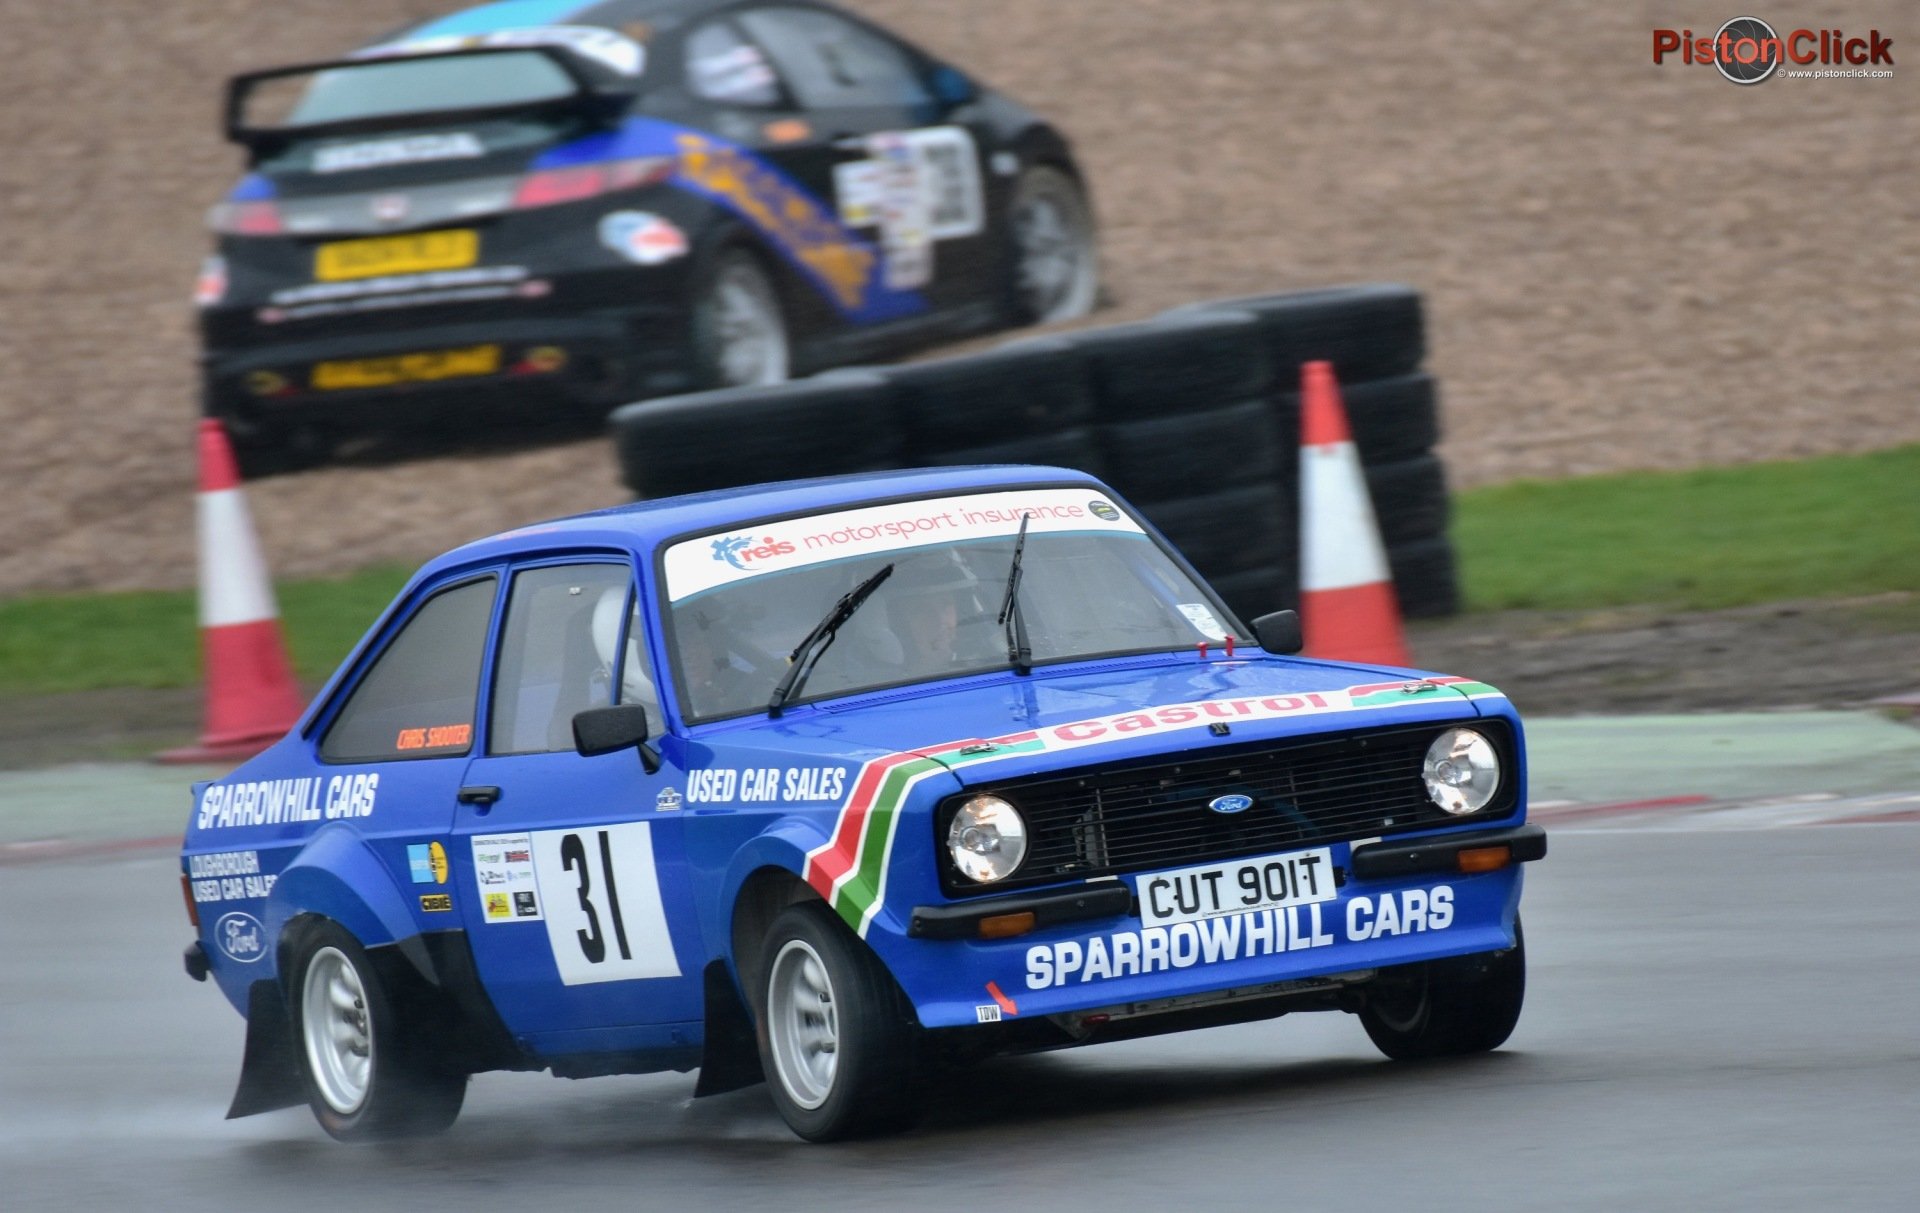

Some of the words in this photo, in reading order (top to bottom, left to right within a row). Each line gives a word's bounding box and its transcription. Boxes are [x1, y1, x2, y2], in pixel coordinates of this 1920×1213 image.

[740, 536, 796, 562] reis
[803, 512, 957, 549] motorsport
[959, 505, 1084, 525] insurance
[198, 776, 322, 829] SPARROWHILL
[325, 773, 379, 819] CARS
[687, 769, 737, 803] USED
[740, 768, 780, 801] CAR
[783, 767, 847, 801] SALES
[192, 880, 222, 902] USED
[221, 877, 246, 900] CAR
[560, 830, 633, 964] 31
[1148, 870, 1224, 919] CUT
[1237, 856, 1321, 906] 901T
[225, 919, 260, 954] Ford
[1025, 903, 1334, 990] SPARROWHILL
[1345, 886, 1455, 942] CARS
